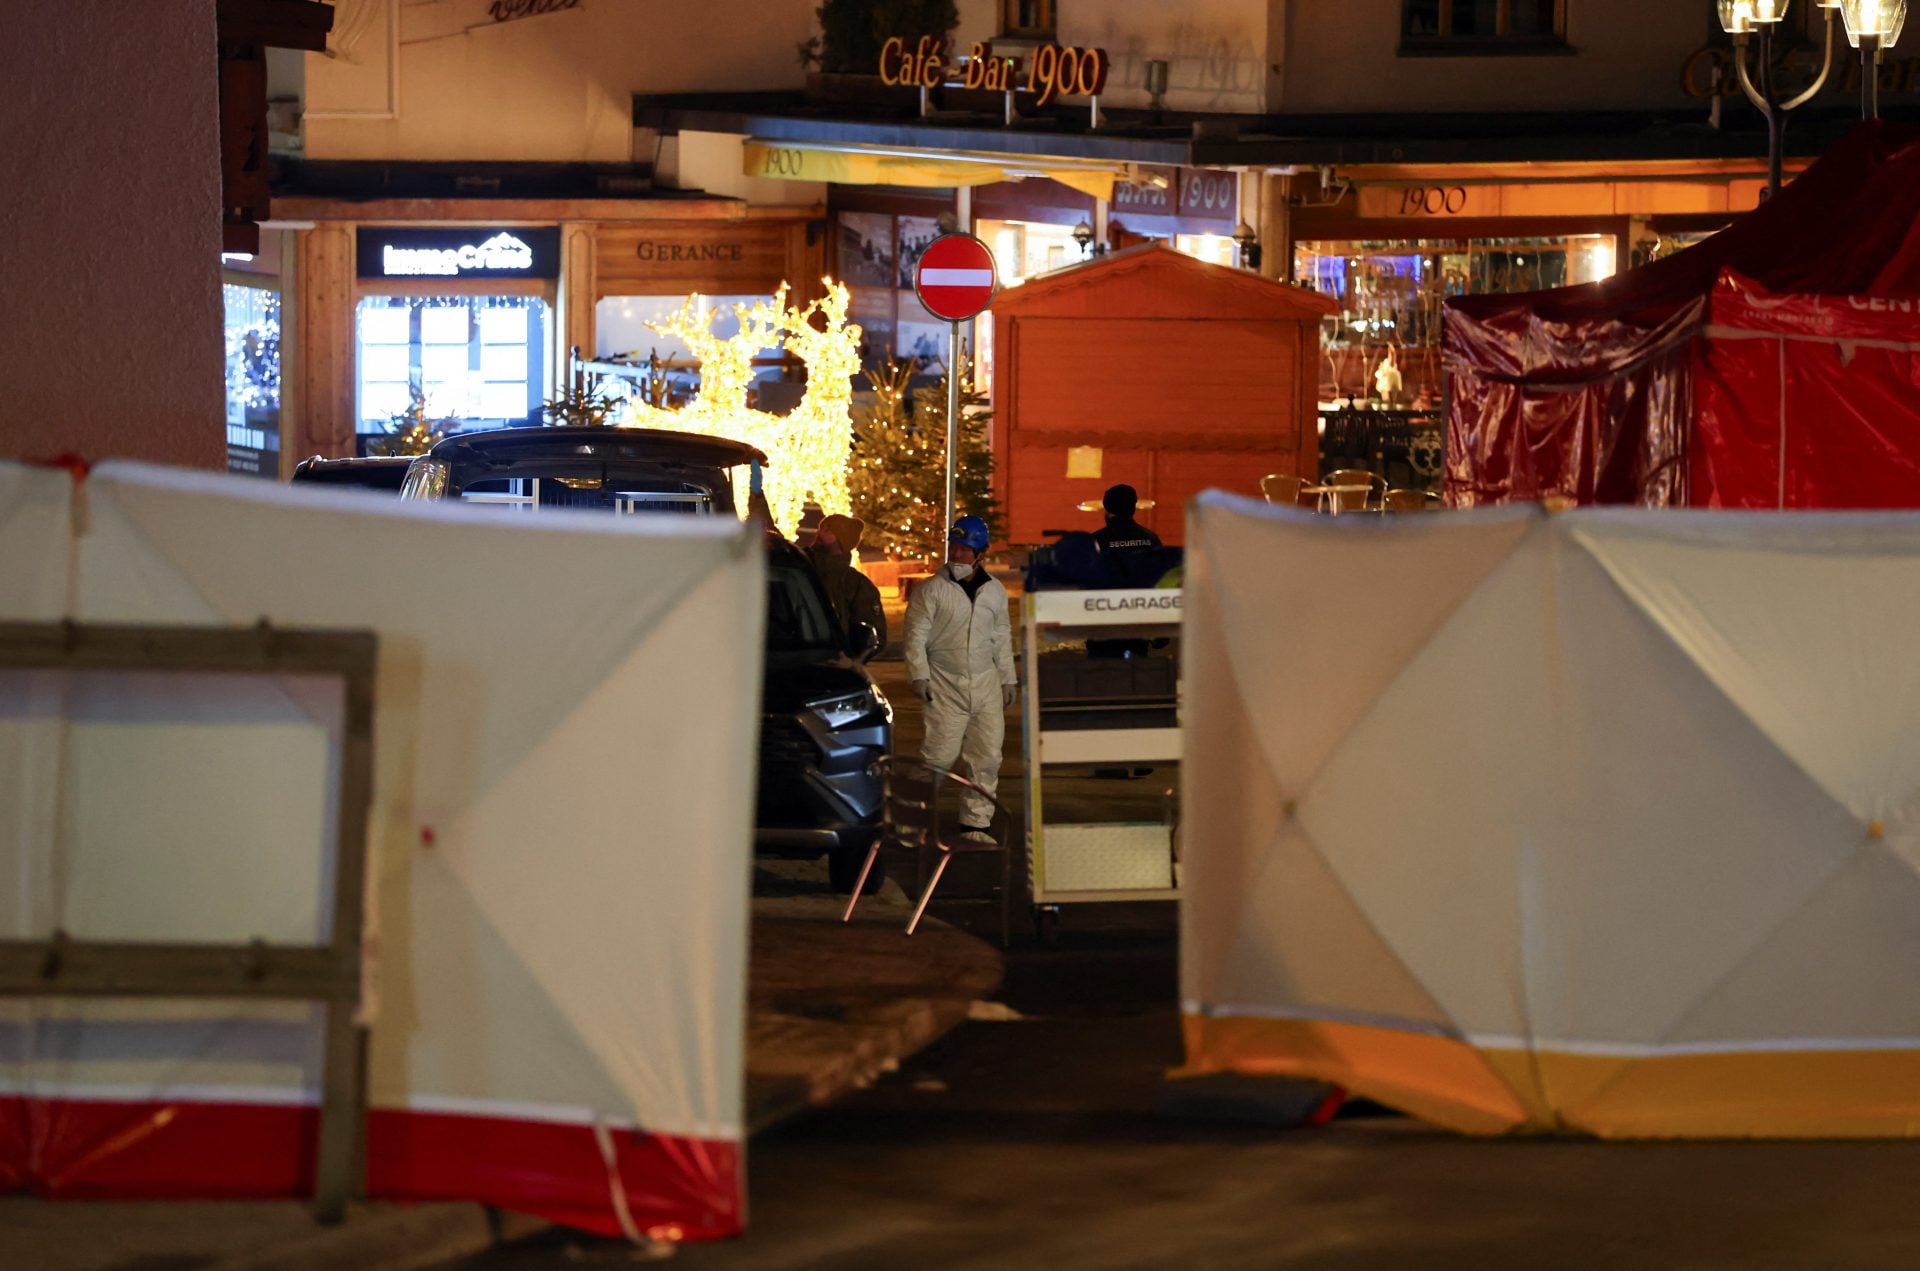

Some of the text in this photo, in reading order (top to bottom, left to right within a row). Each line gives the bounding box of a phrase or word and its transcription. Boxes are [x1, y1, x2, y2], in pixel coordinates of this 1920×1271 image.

[879, 34, 943, 88] Café
[964, 42, 1013, 91] Bar
[1026, 44, 1100, 107] 1900
[764, 147, 803, 176] 1900
[1180, 174, 1232, 209] 1900
[1399, 186, 1467, 216] 1900
[1108, 539, 1152, 548] SECURITAS
[1083, 595, 1183, 612] ECLAIRAGE
